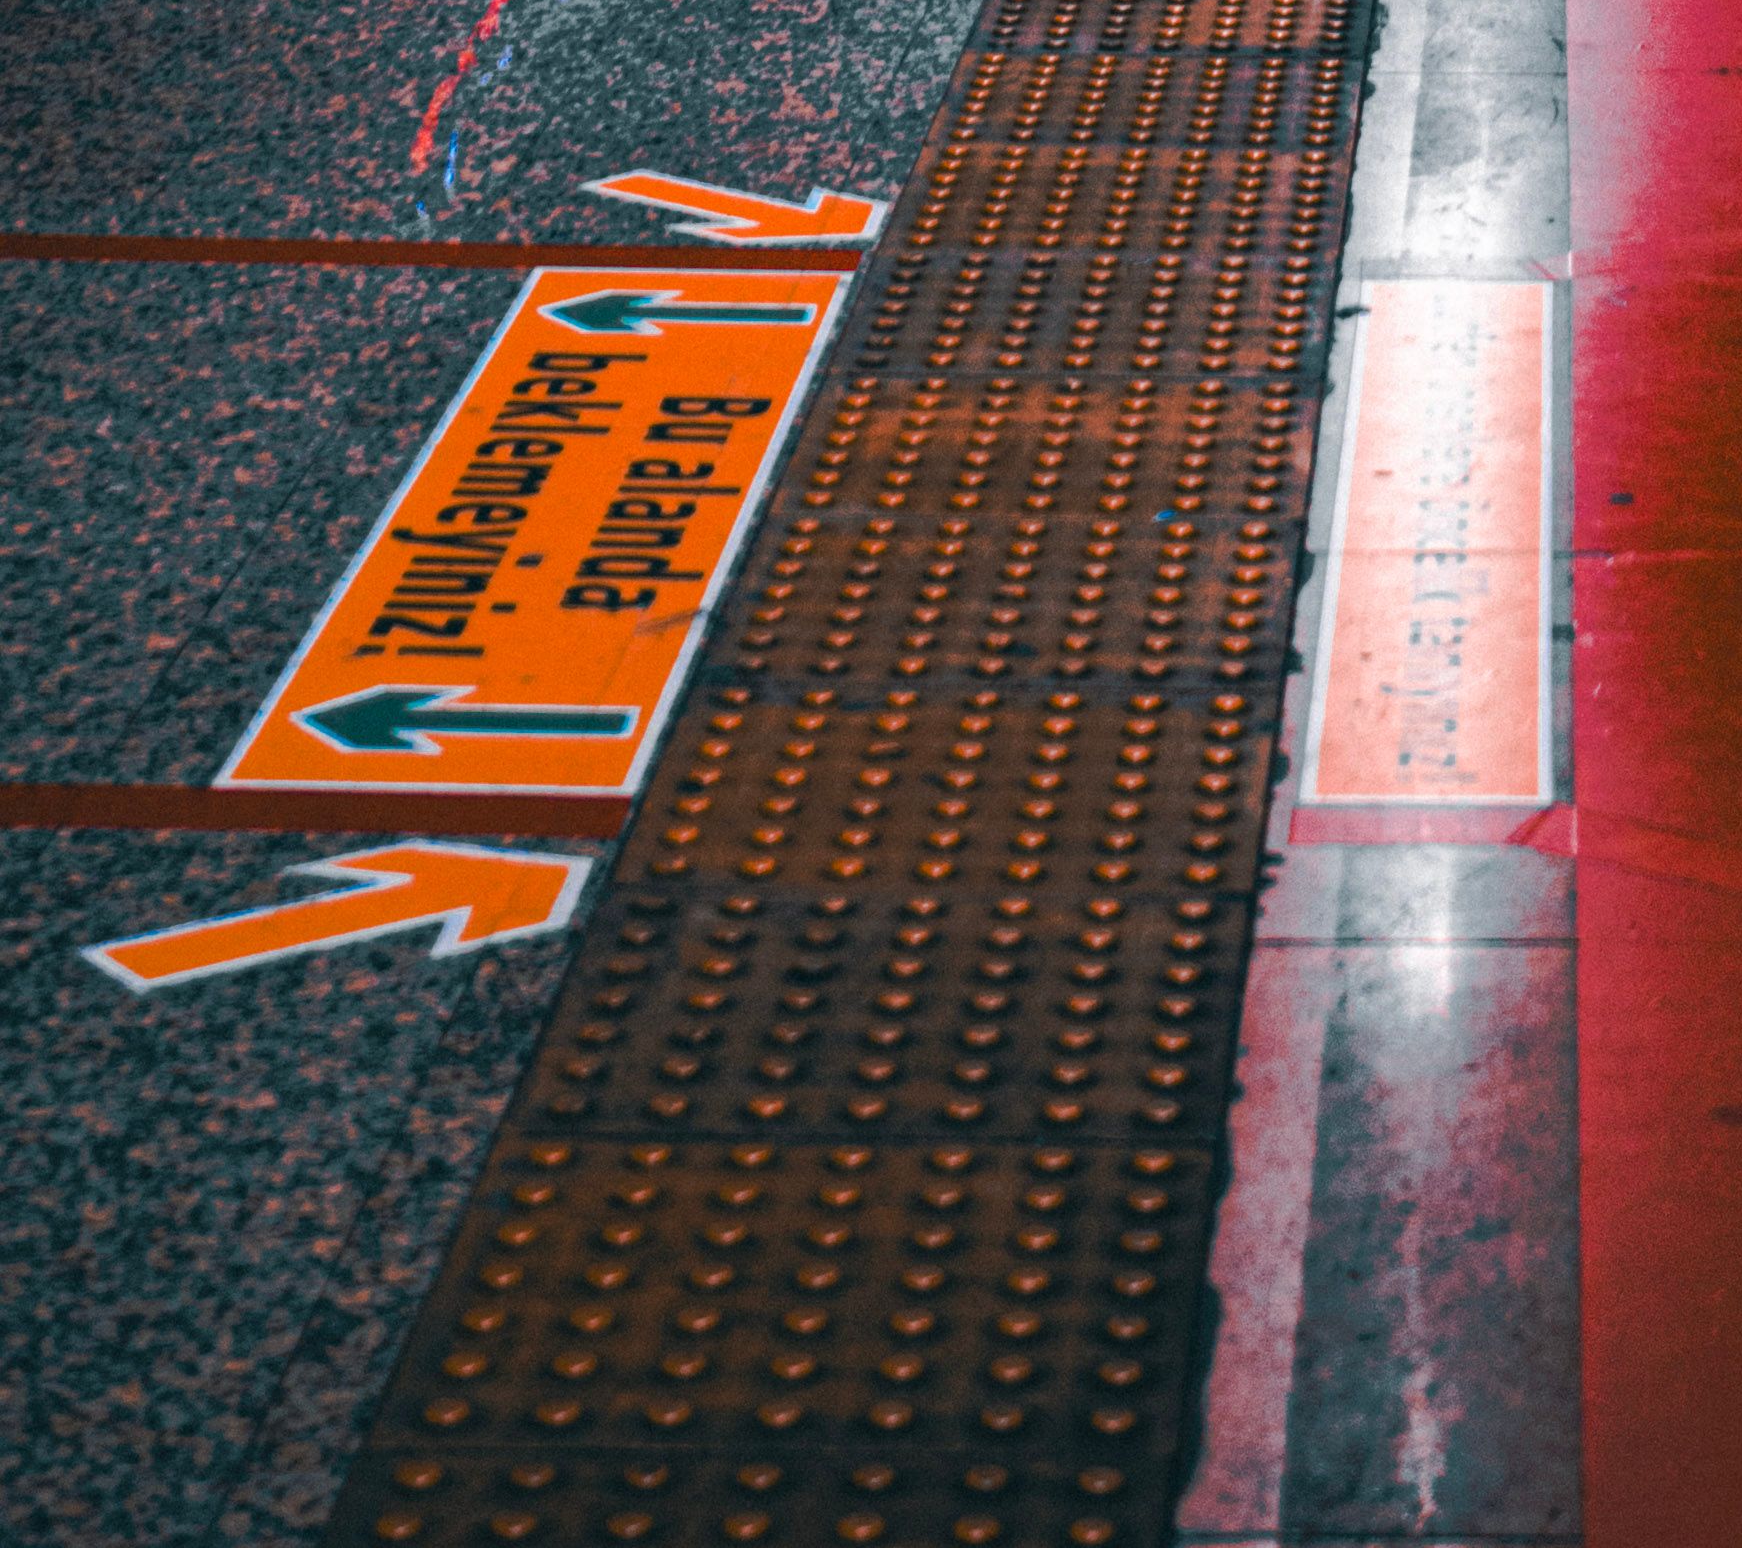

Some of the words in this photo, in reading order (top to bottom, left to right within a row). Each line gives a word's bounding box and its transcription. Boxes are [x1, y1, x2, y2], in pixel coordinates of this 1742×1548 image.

[646, 395, 774, 446] Bu
[341, 350, 649, 661] beklemeyiniz!
[560, 458, 742, 613] alanda
